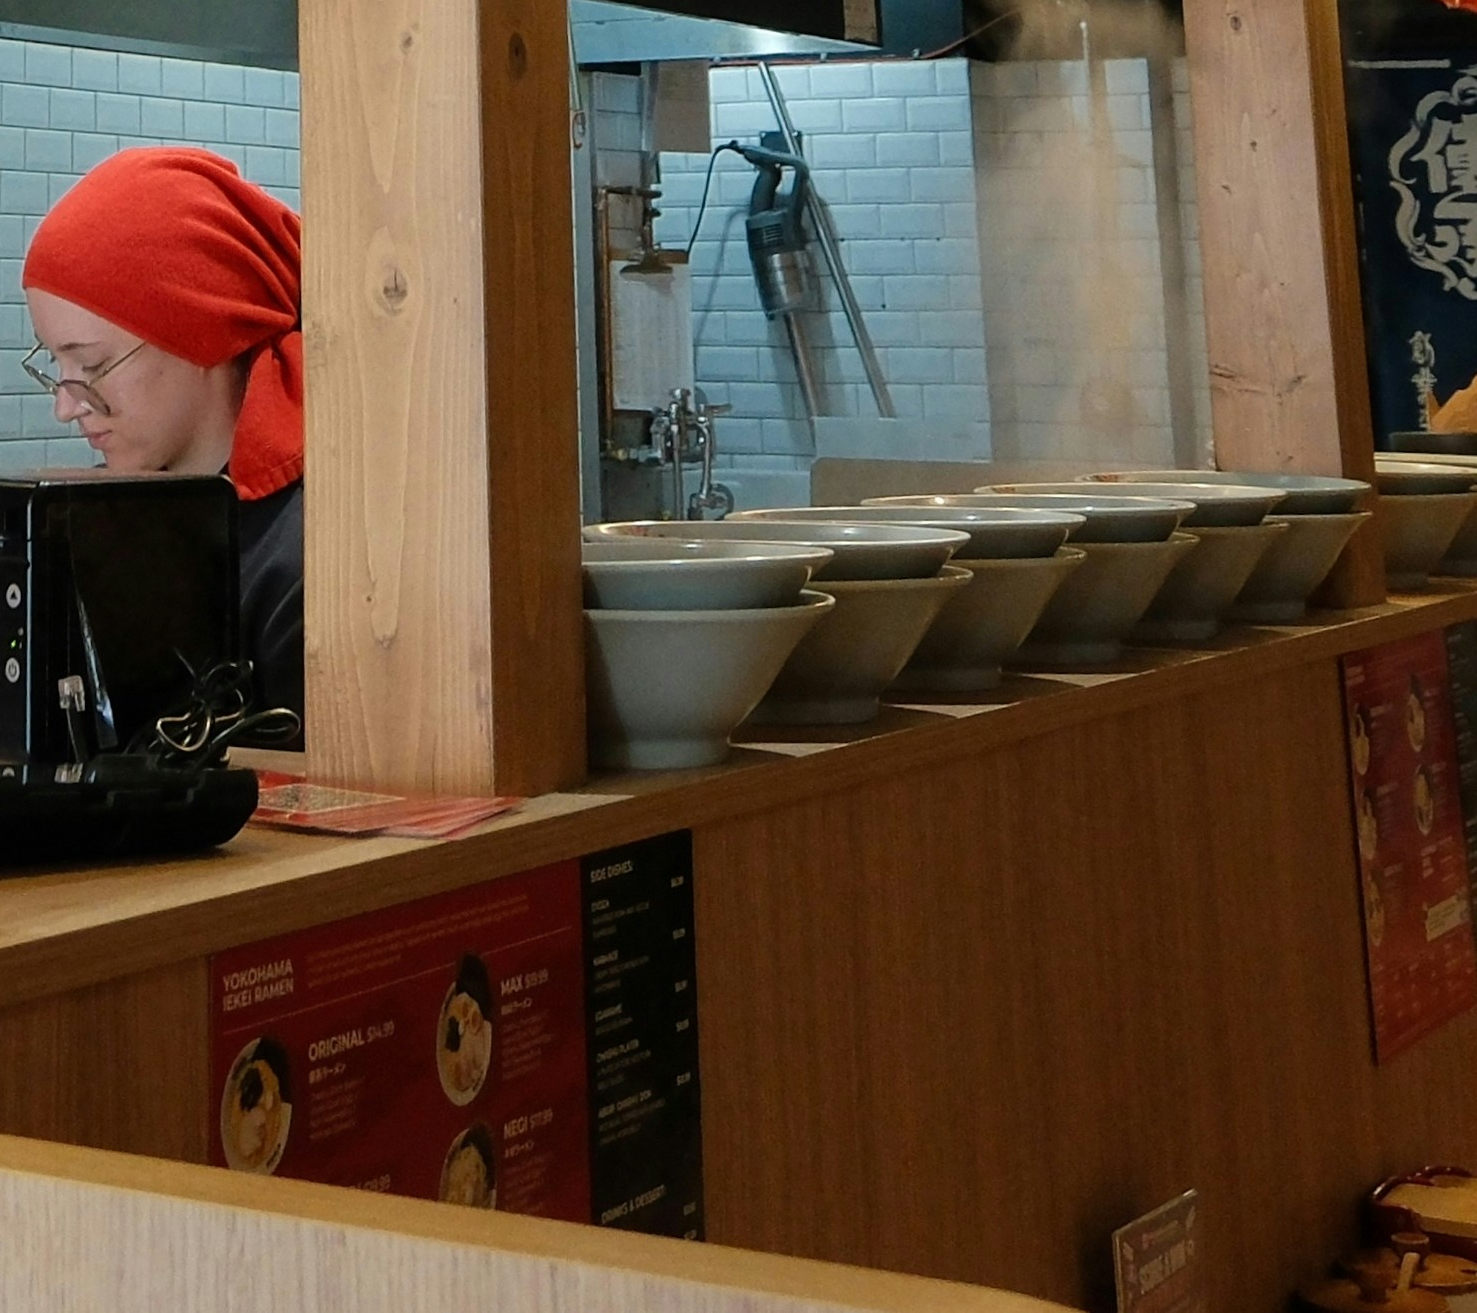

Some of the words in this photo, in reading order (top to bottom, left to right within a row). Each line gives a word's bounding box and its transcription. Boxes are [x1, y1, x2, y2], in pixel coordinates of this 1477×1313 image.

[222, 957, 294, 992] YOKOHAMA
[500, 973, 523, 996] MAX
[254, 977, 294, 1005] RAMEN
[308, 1029, 365, 1062] ORIGINAL
[503, 1117, 528, 1141] NEGI
